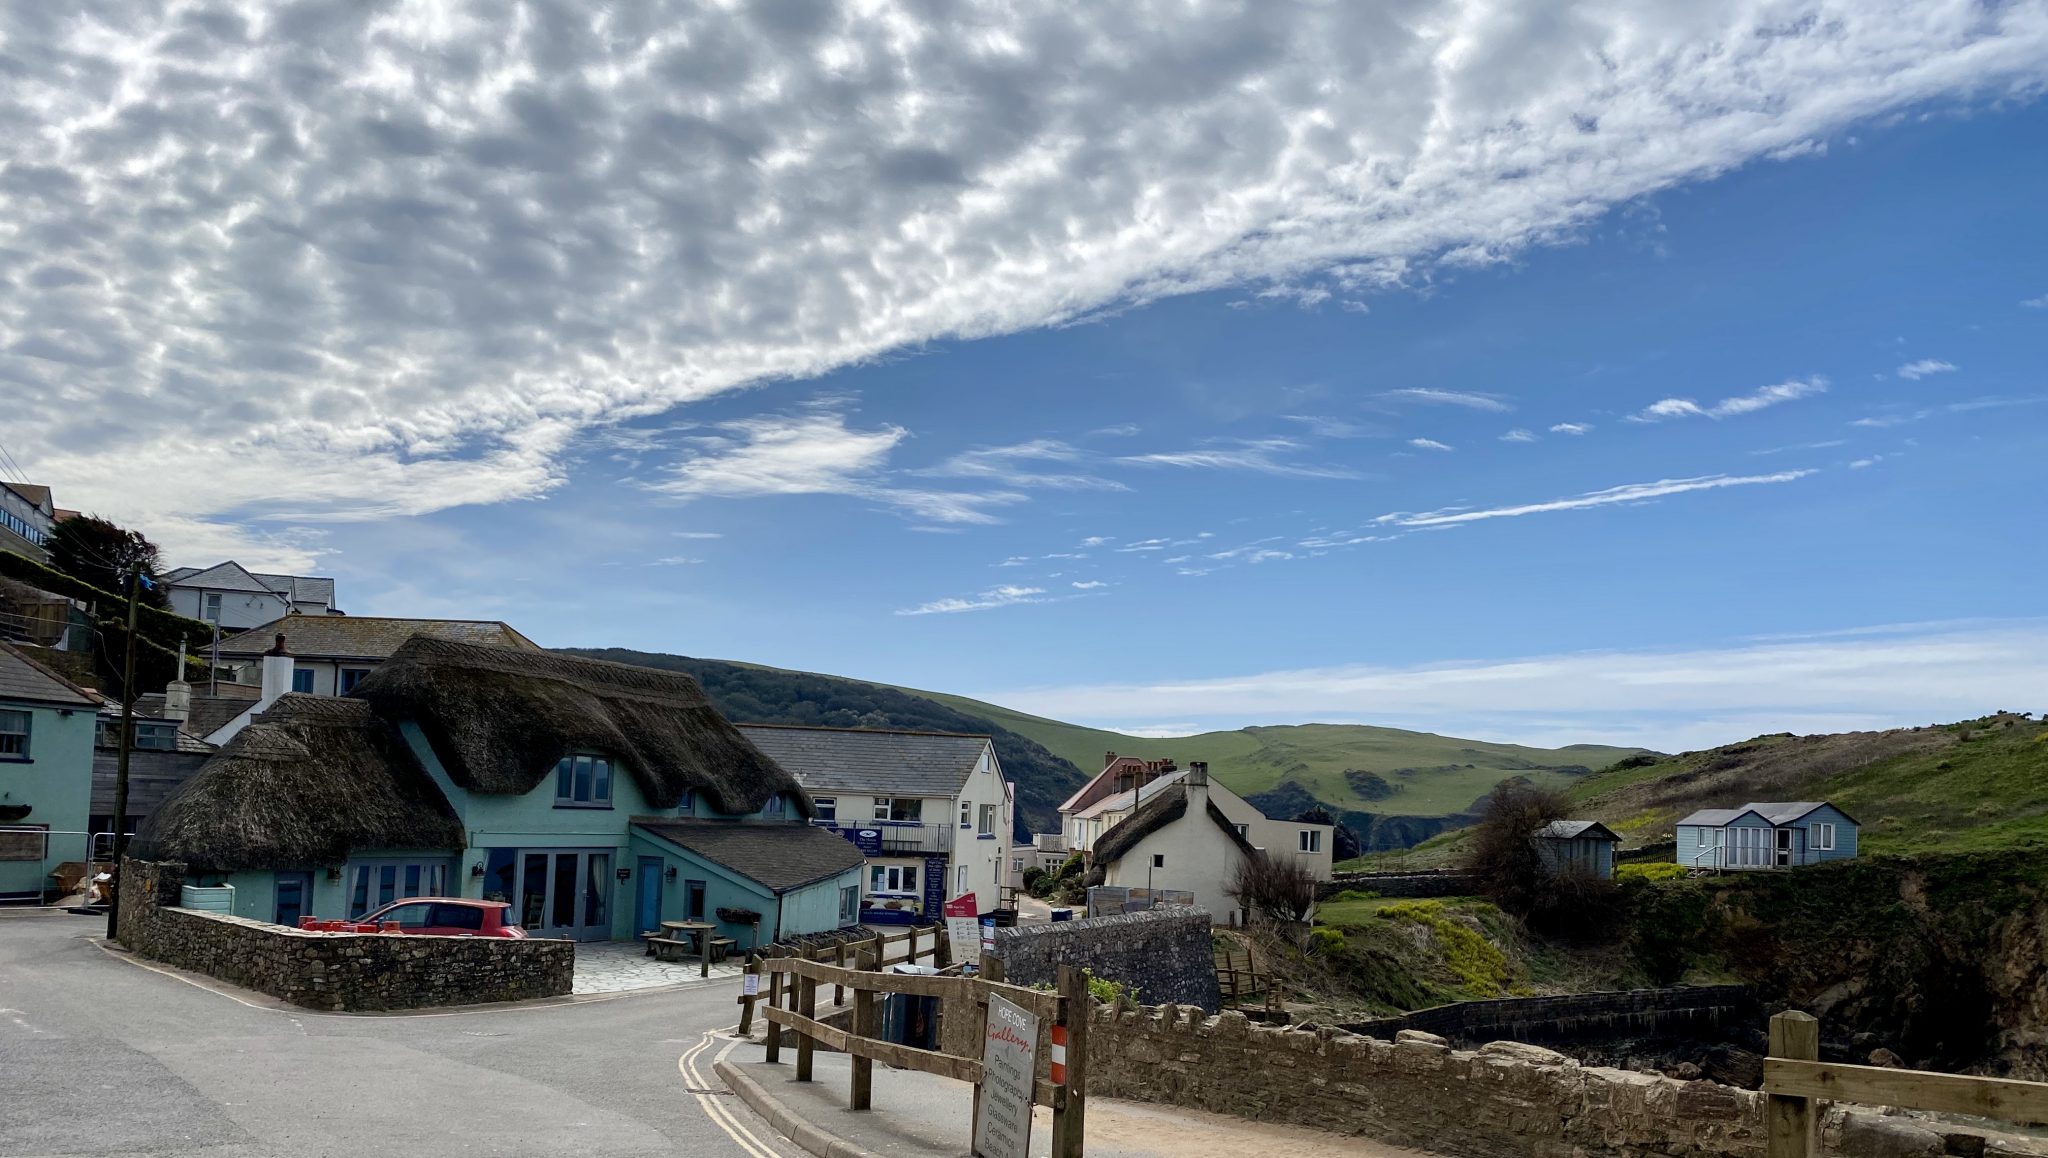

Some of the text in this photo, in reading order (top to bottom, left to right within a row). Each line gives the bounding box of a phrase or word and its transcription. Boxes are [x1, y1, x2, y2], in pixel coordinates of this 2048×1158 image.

[998, 1006, 1026, 1030] HOPE COVE
[995, 1054, 1020, 1080] Paintings
[991, 1089, 1018, 1117] Jewellery
[988, 1104, 1017, 1133] Glassware
[984, 1137, 1004, 1158] Beach
[987, 1121, 1014, 1149] Ceramics
